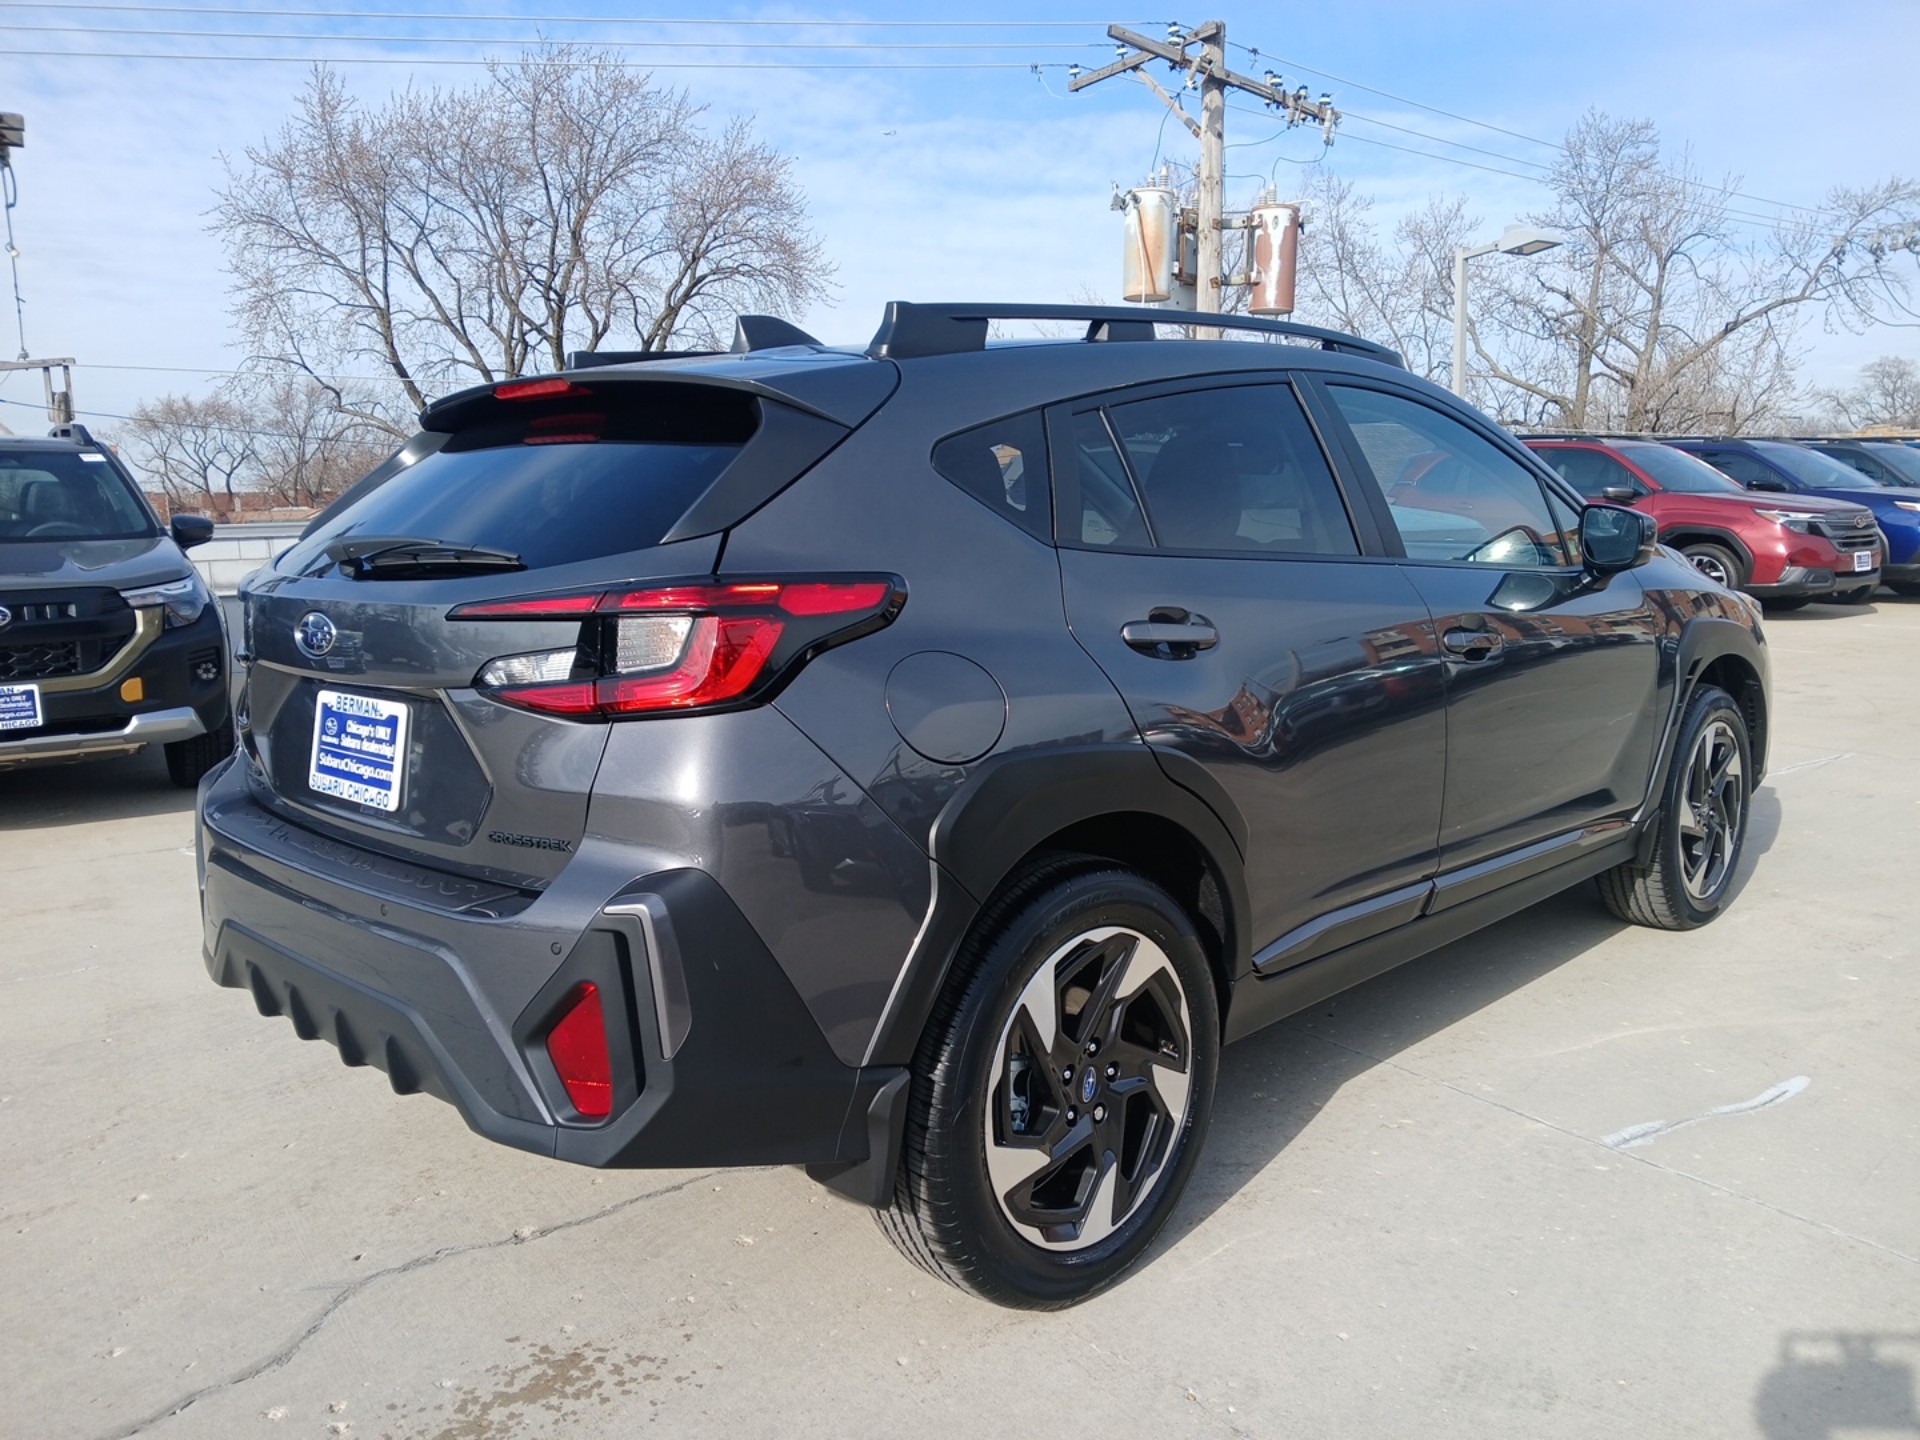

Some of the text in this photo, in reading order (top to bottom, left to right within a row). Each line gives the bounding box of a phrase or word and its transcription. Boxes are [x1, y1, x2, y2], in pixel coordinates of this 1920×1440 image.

[335, 695, 379, 716] BERMAN
[319, 752, 393, 781] SubaruChicago.com
[311, 774, 390, 808] SUBARU CHICAGO
[487, 831, 574, 853] CROSSTREK
